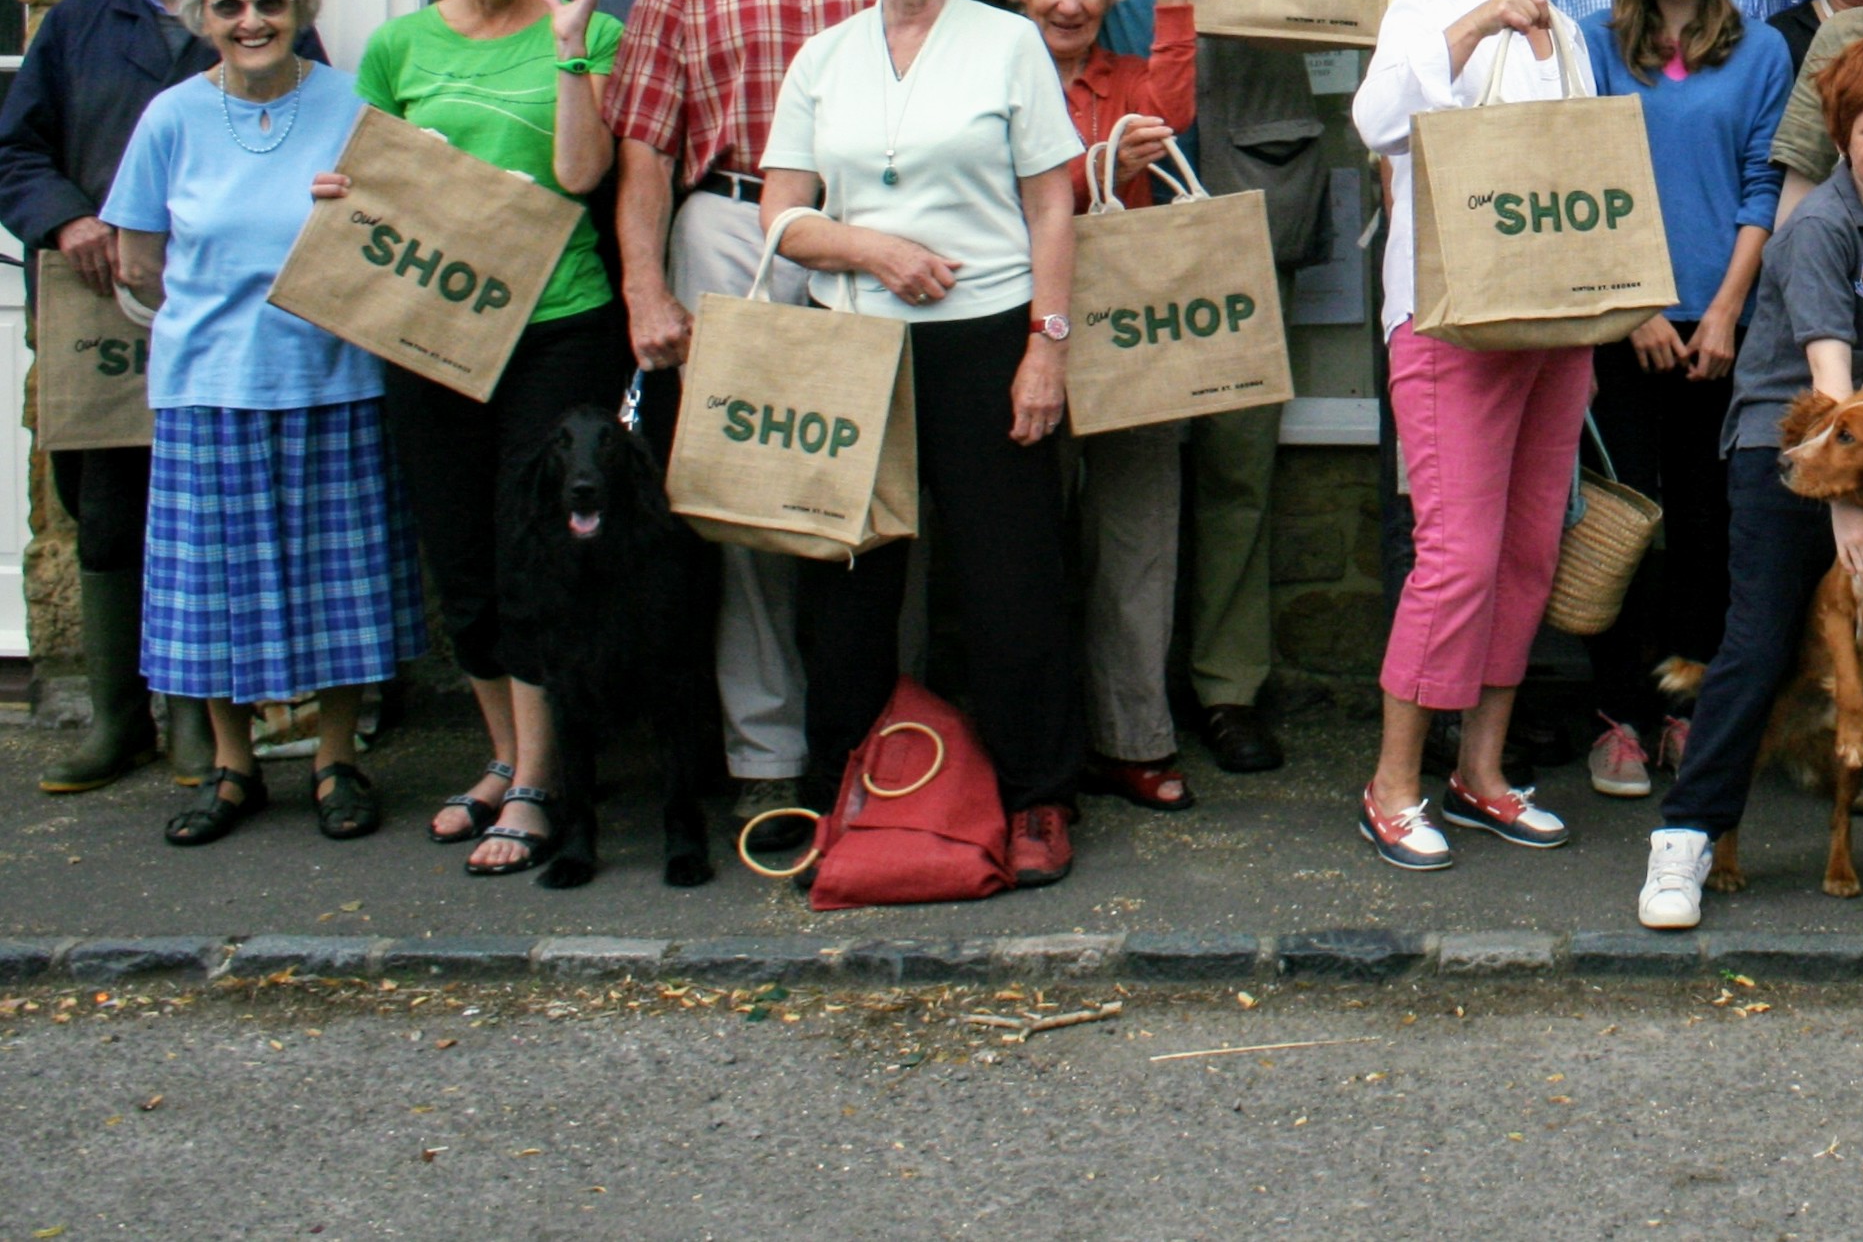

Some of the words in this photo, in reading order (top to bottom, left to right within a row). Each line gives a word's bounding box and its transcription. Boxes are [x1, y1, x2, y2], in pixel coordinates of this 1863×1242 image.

[1493, 188, 1634, 235] SHOP
[361, 224, 512, 315] SHOP
[1110, 293, 1256, 349] SHOP
[722, 399, 860, 458] SHOP
